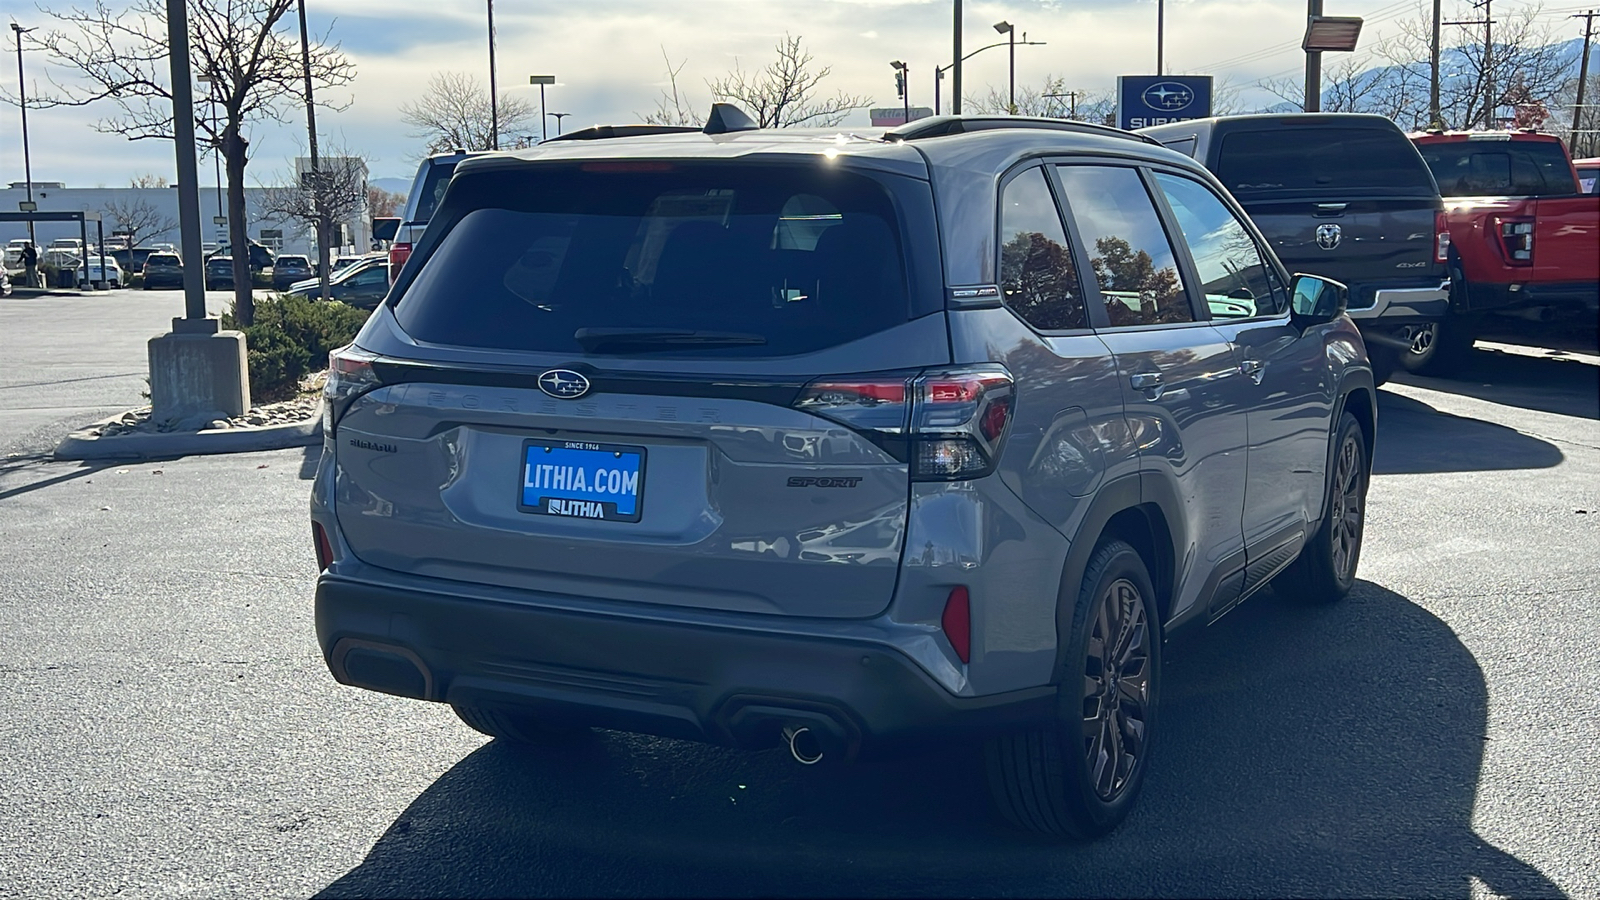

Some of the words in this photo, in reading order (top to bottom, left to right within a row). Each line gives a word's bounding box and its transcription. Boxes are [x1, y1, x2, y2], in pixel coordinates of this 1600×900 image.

[428, 391, 721, 423] FORESTER
[350, 438, 398, 453] SUBARU
[565, 441, 584, 450] SINCE
[585, 443, 600, 451] 1946
[524, 463, 639, 496] LITHIA.COM
[786, 476, 863, 488] SPORT
[560, 500, 604, 519] LITHIA
